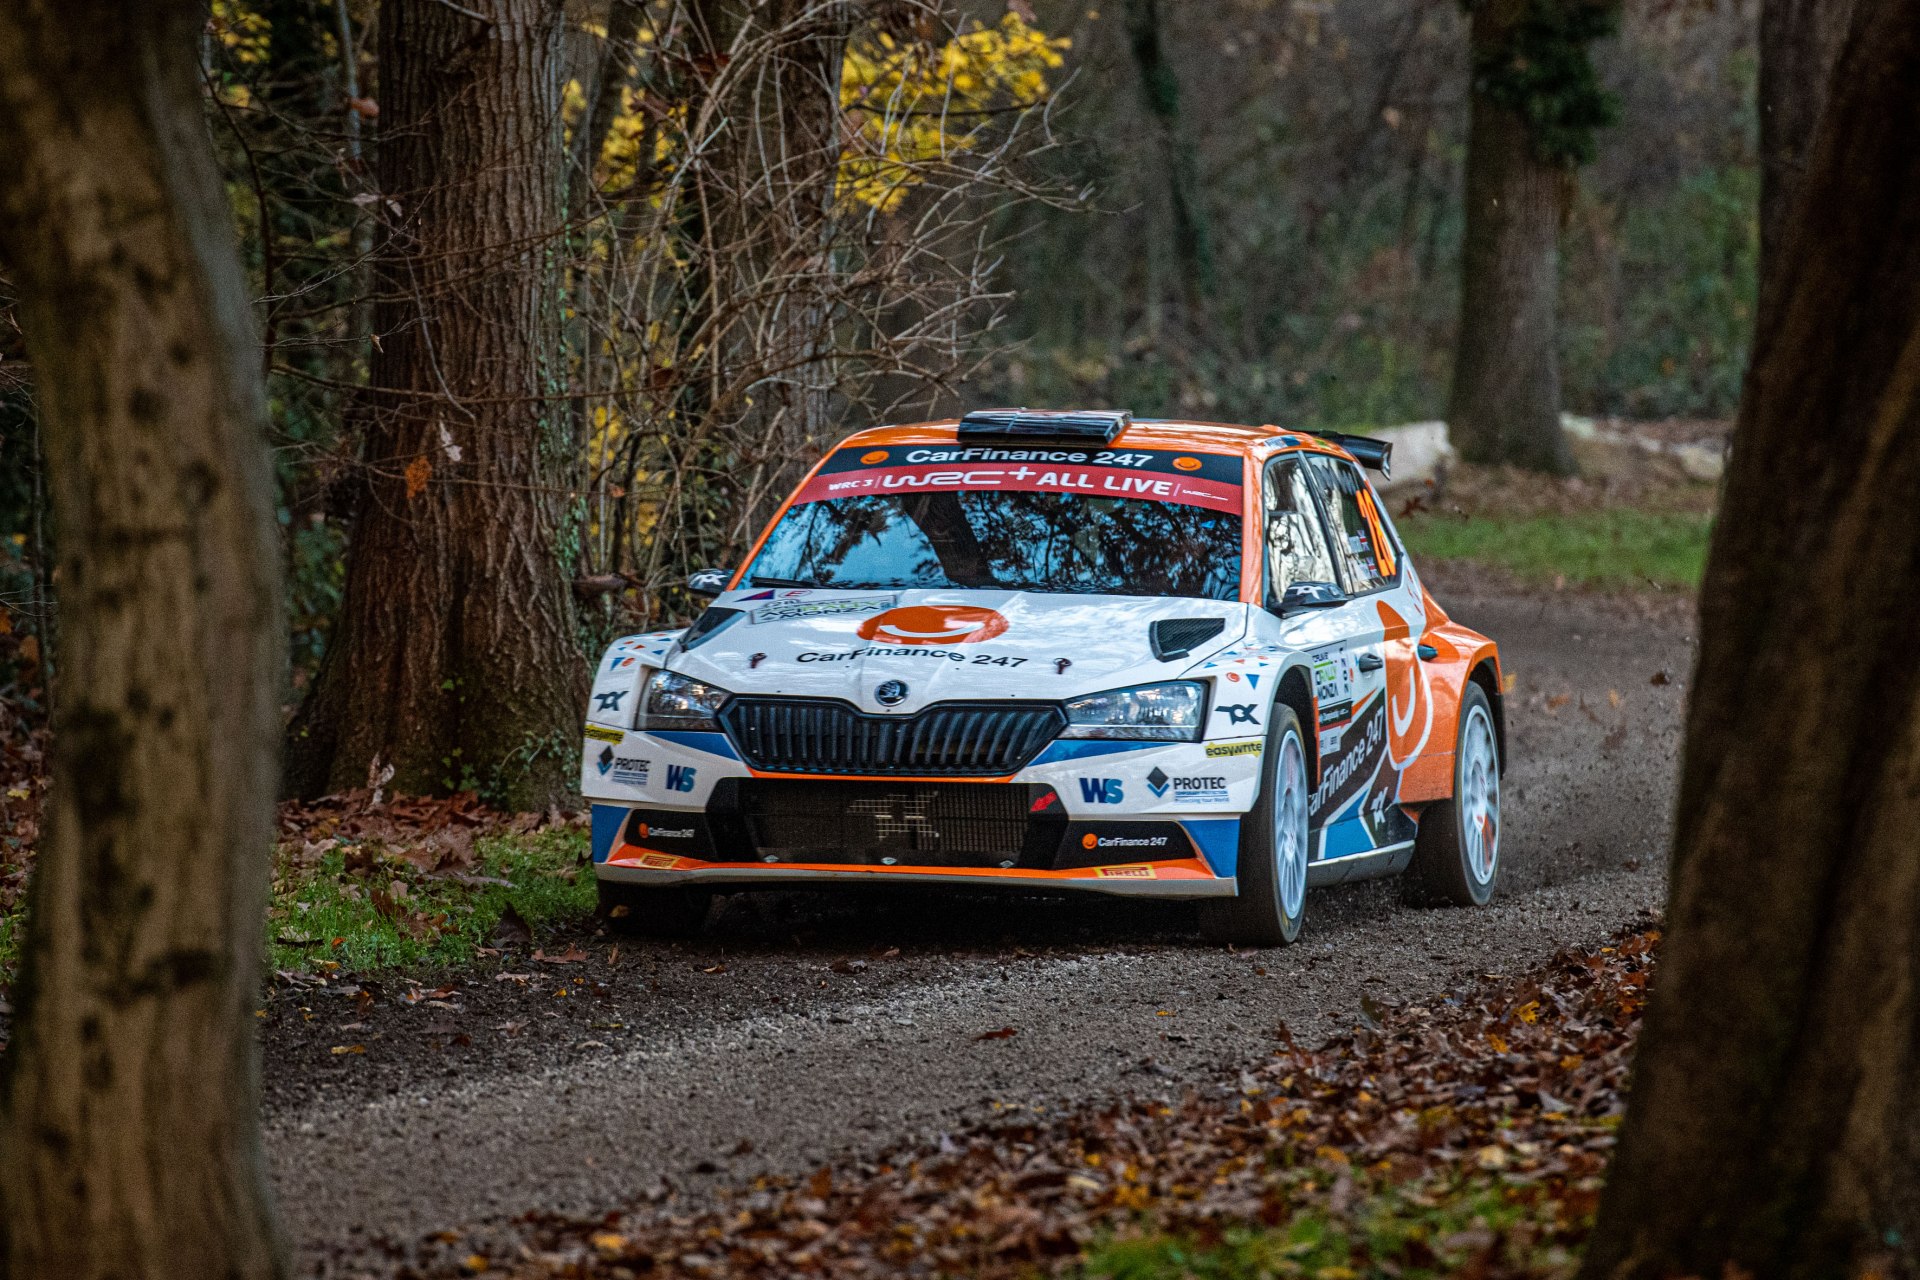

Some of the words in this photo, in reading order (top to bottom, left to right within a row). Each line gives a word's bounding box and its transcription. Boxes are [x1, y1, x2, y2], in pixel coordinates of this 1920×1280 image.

[905, 447, 1087, 464] CarFinance
[1095, 450, 1153, 468] 247
[828, 480, 860, 491] WRC
[863, 479, 874, 487] 3
[1036, 470, 1094, 489] ALL
[1104, 474, 1173, 496] LIVE
[780, 606, 880, 619] MONZA
[796, 646, 966, 663] CarFinance
[971, 654, 1029, 668] 247
[1206, 742, 1262, 757] easywrite
[615, 757, 651, 772] PROTEC
[1308, 738, 1365, 816] arFinance
[1366, 705, 1384, 757] 247
[665, 764, 697, 793] WS
[1173, 776, 1227, 790] PROTEC
[1079, 777, 1124, 804] WS
[1097, 837, 1149, 847] CarFinance
[1150, 836, 1168, 846] 247
[1101, 866, 1150, 877] PIRELLI
